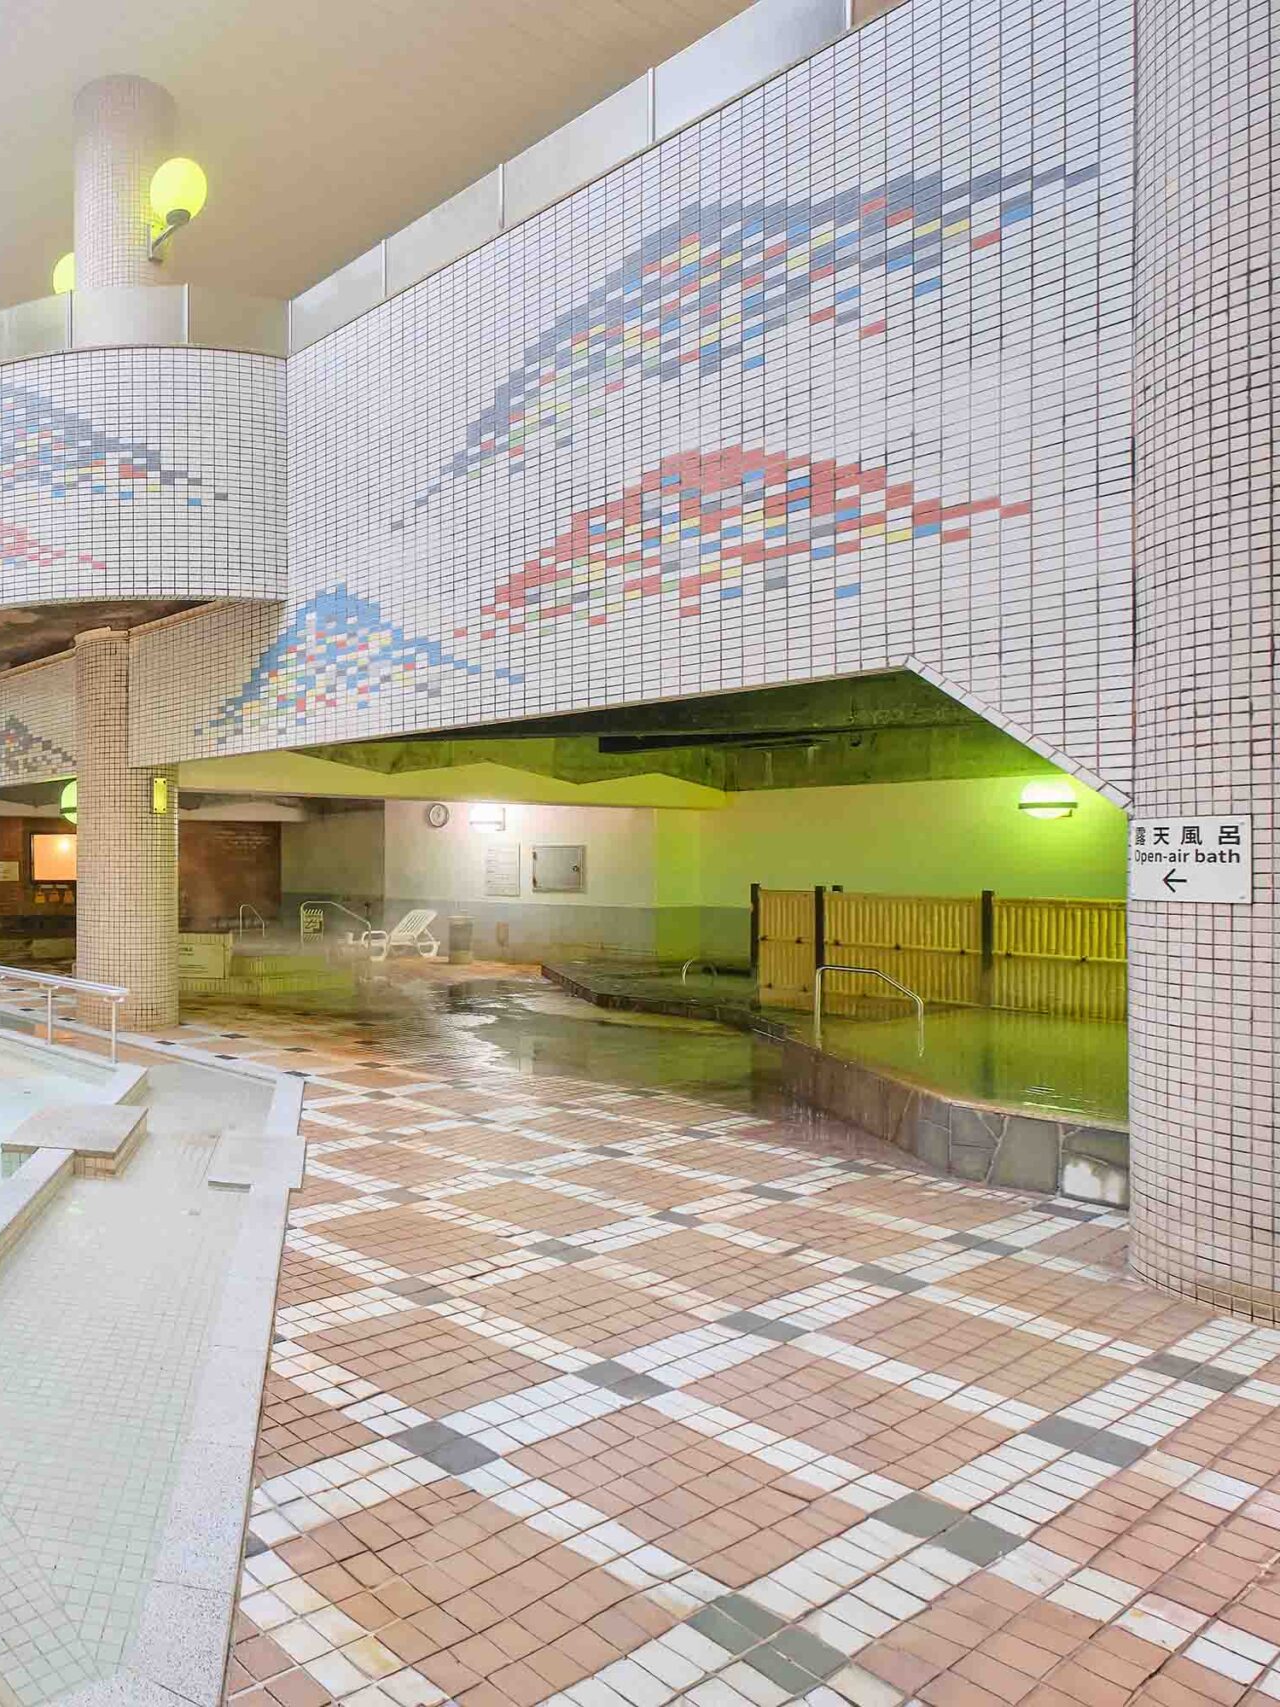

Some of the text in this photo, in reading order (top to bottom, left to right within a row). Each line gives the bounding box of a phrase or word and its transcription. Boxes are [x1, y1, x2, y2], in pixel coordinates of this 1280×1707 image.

[1134, 825, 1241, 846] 露天風呂
[1134, 848, 1241, 865] Open-air bath
